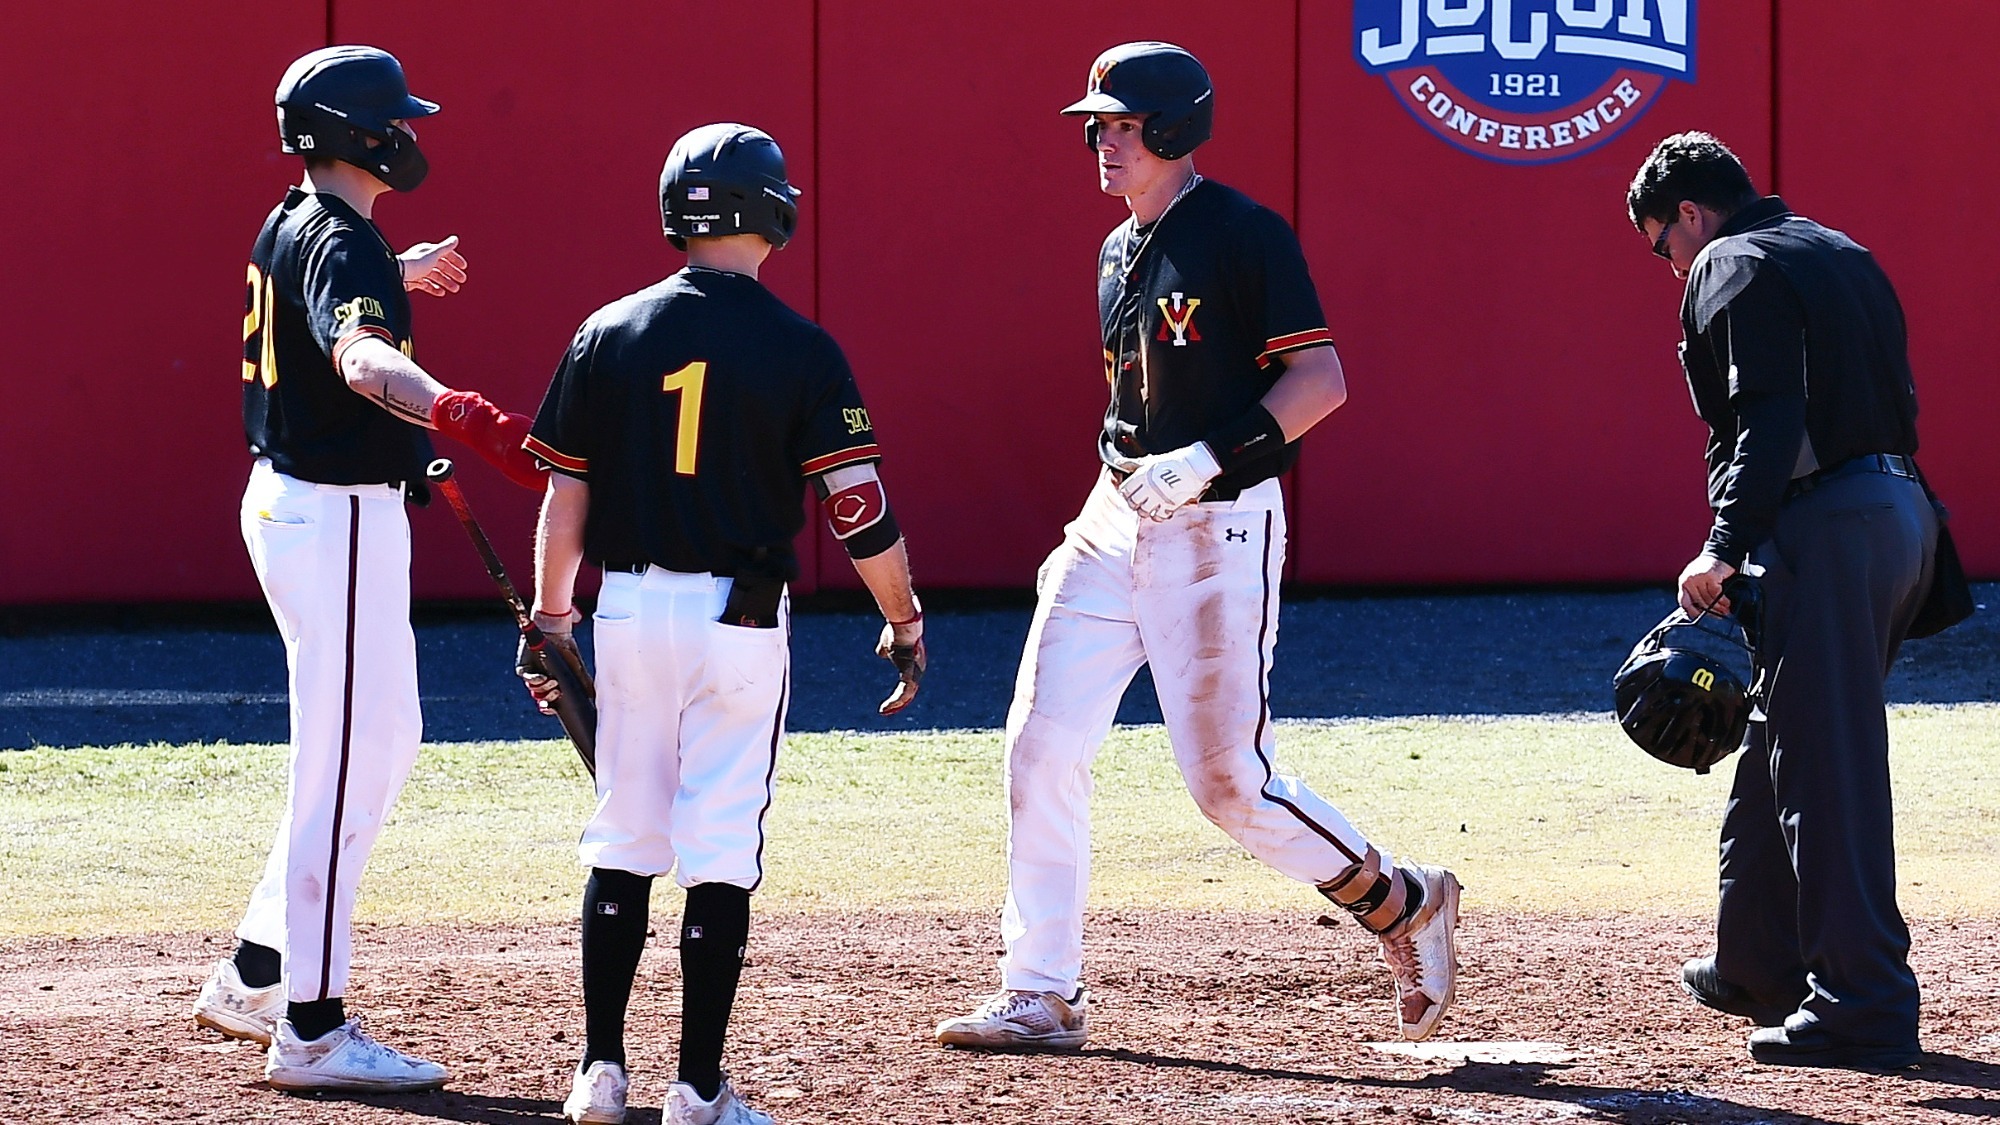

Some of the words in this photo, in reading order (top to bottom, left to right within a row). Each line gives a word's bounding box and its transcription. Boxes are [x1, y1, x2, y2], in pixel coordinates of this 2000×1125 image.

[1489, 73, 1561, 97] 1921
[1409, 75, 1641, 151] CONFERENCE
[297, 134, 315, 150] 20
[734, 212, 740, 228] 1
[242, 262, 278, 390] 20
[662, 361, 708, 476] 1
